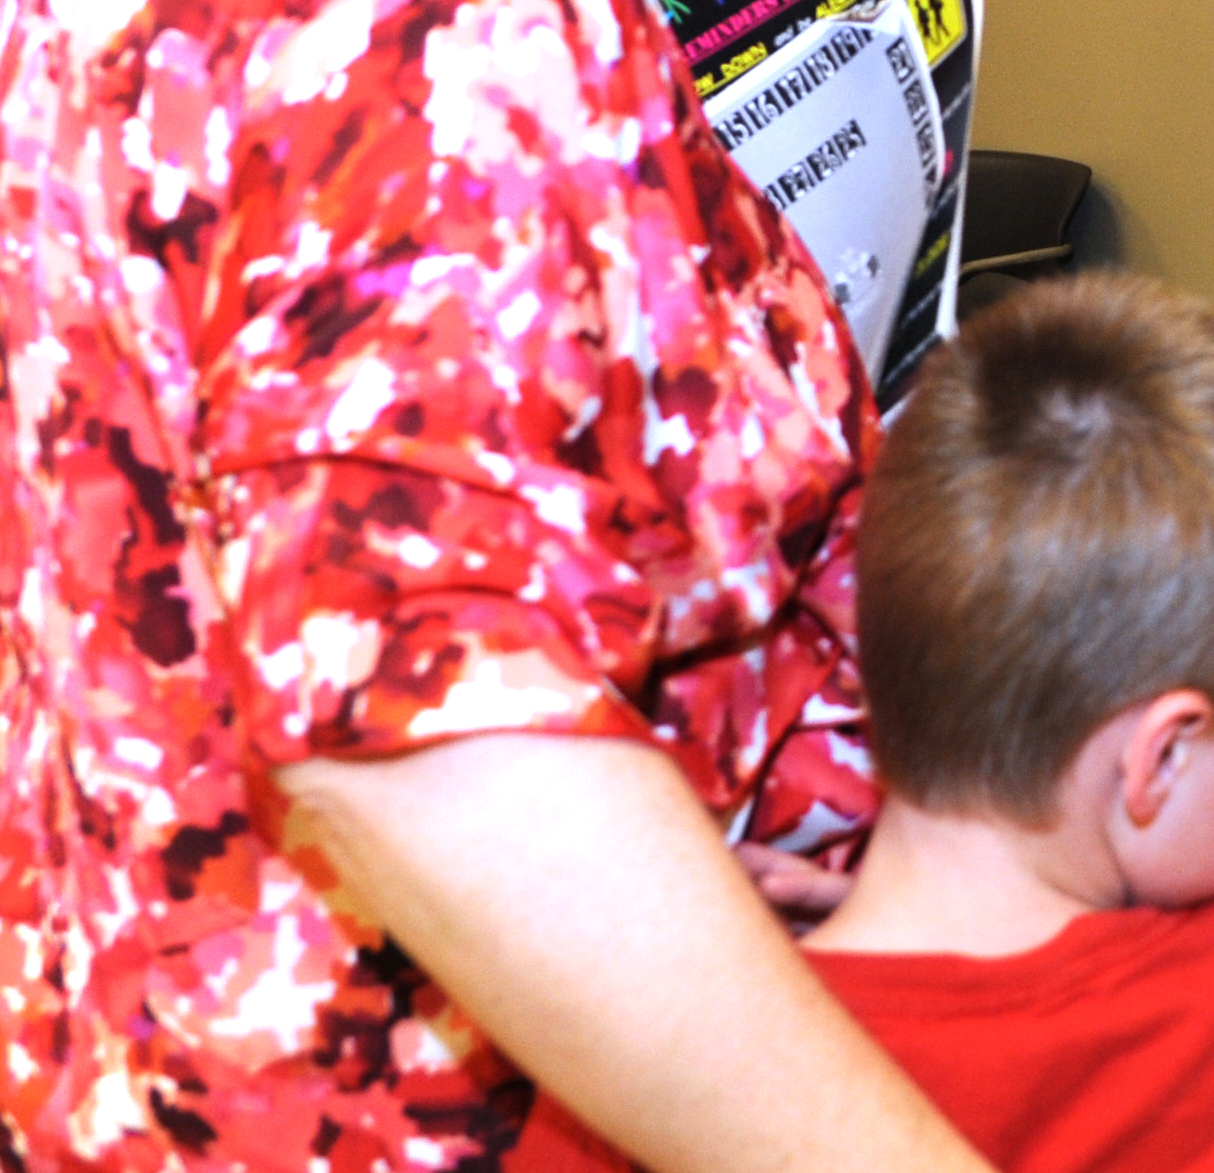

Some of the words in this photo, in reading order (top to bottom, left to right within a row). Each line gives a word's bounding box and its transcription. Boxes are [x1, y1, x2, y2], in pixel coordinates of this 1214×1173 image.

[717, 111, 752, 148] 15
[747, 92, 782, 127] 16
[778, 68, 811, 104] 17
[806, 48, 838, 85] 18
[832, 27, 866, 63] 19
[720, 42, 768, 78] DOWN
[780, 164, 813, 202] 27
[808, 140, 842, 180] 26
[834, 121, 865, 159] 25
